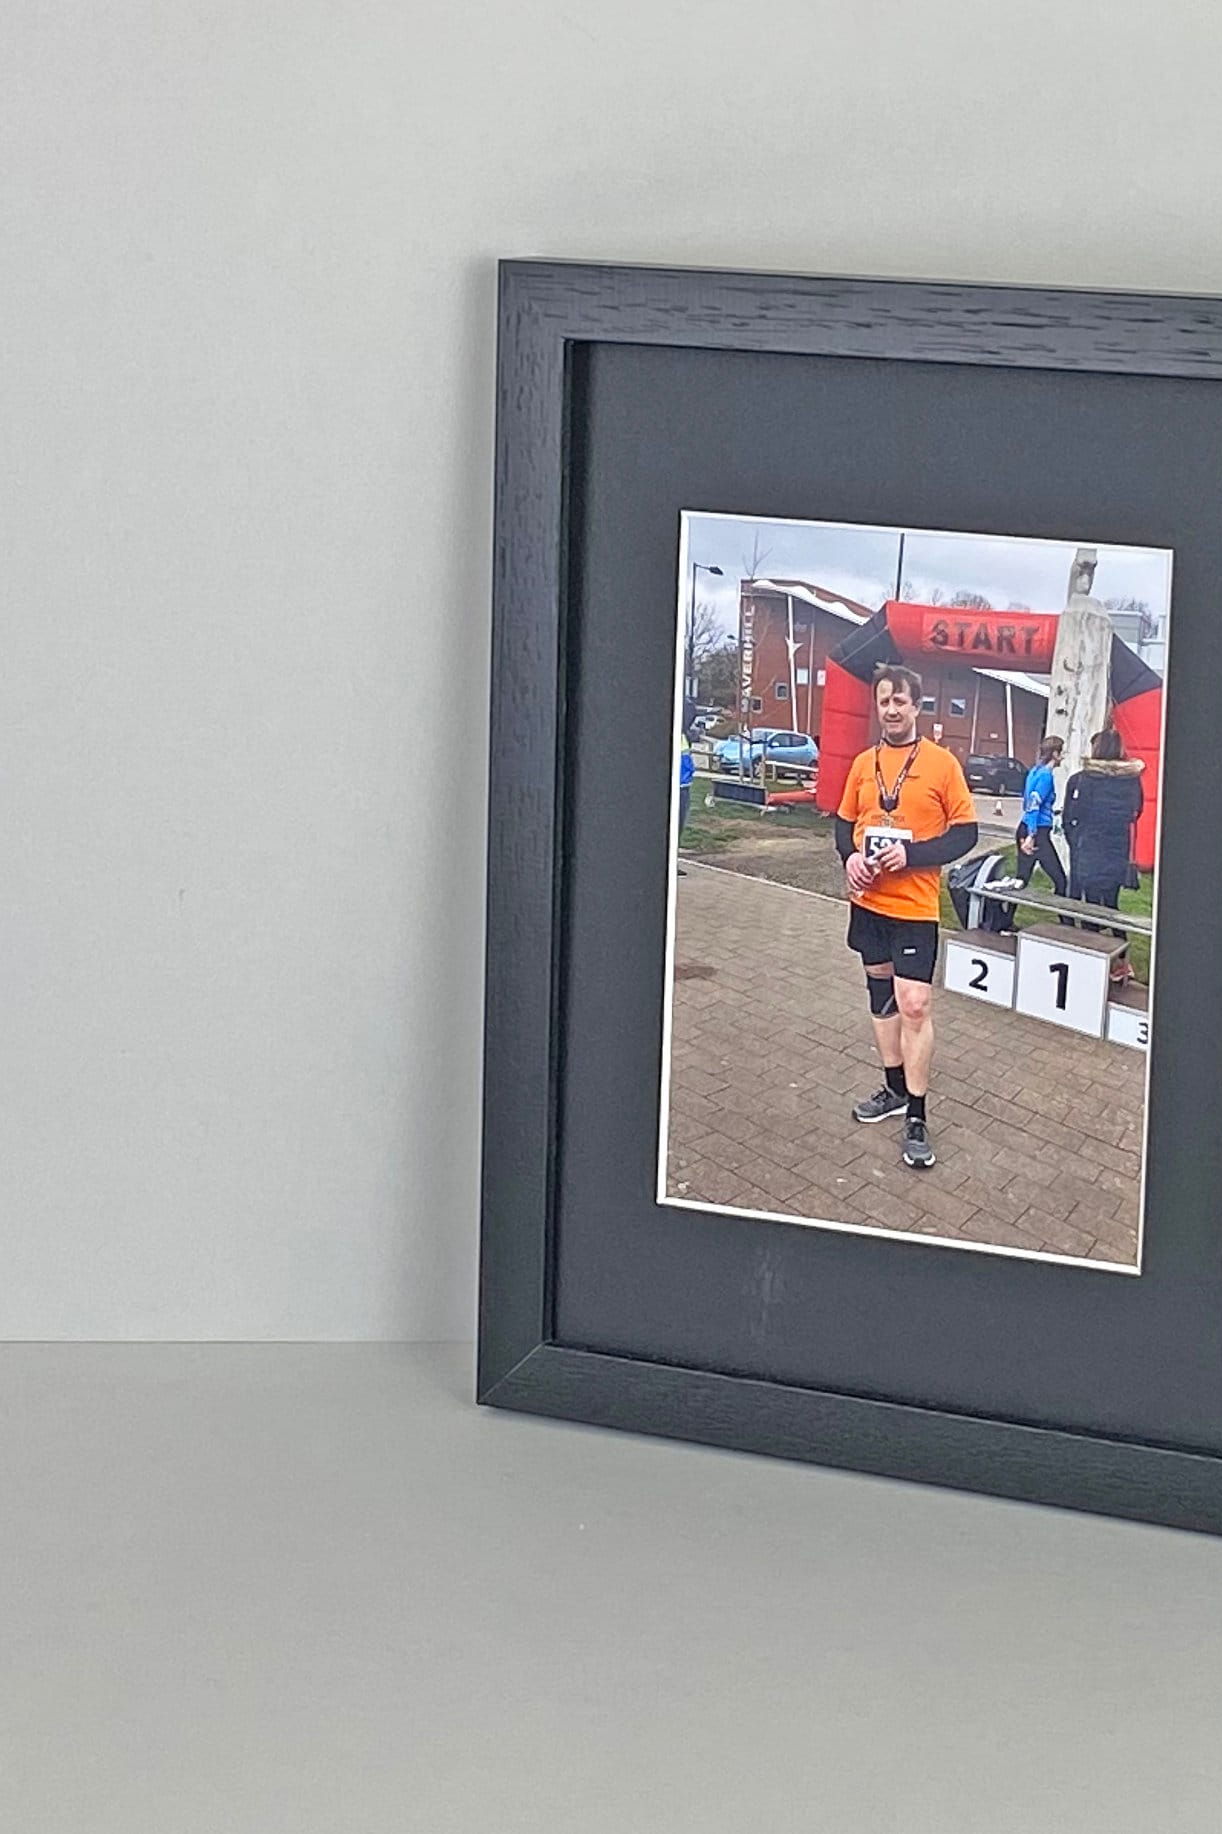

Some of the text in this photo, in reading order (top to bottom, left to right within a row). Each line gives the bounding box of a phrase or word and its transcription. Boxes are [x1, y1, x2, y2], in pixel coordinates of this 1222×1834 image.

[930, 619, 1039, 656] START
[968, 958, 989, 992] 2
[1048, 962, 1069, 1011] 1
[1136, 1022, 1148, 1045] 3
